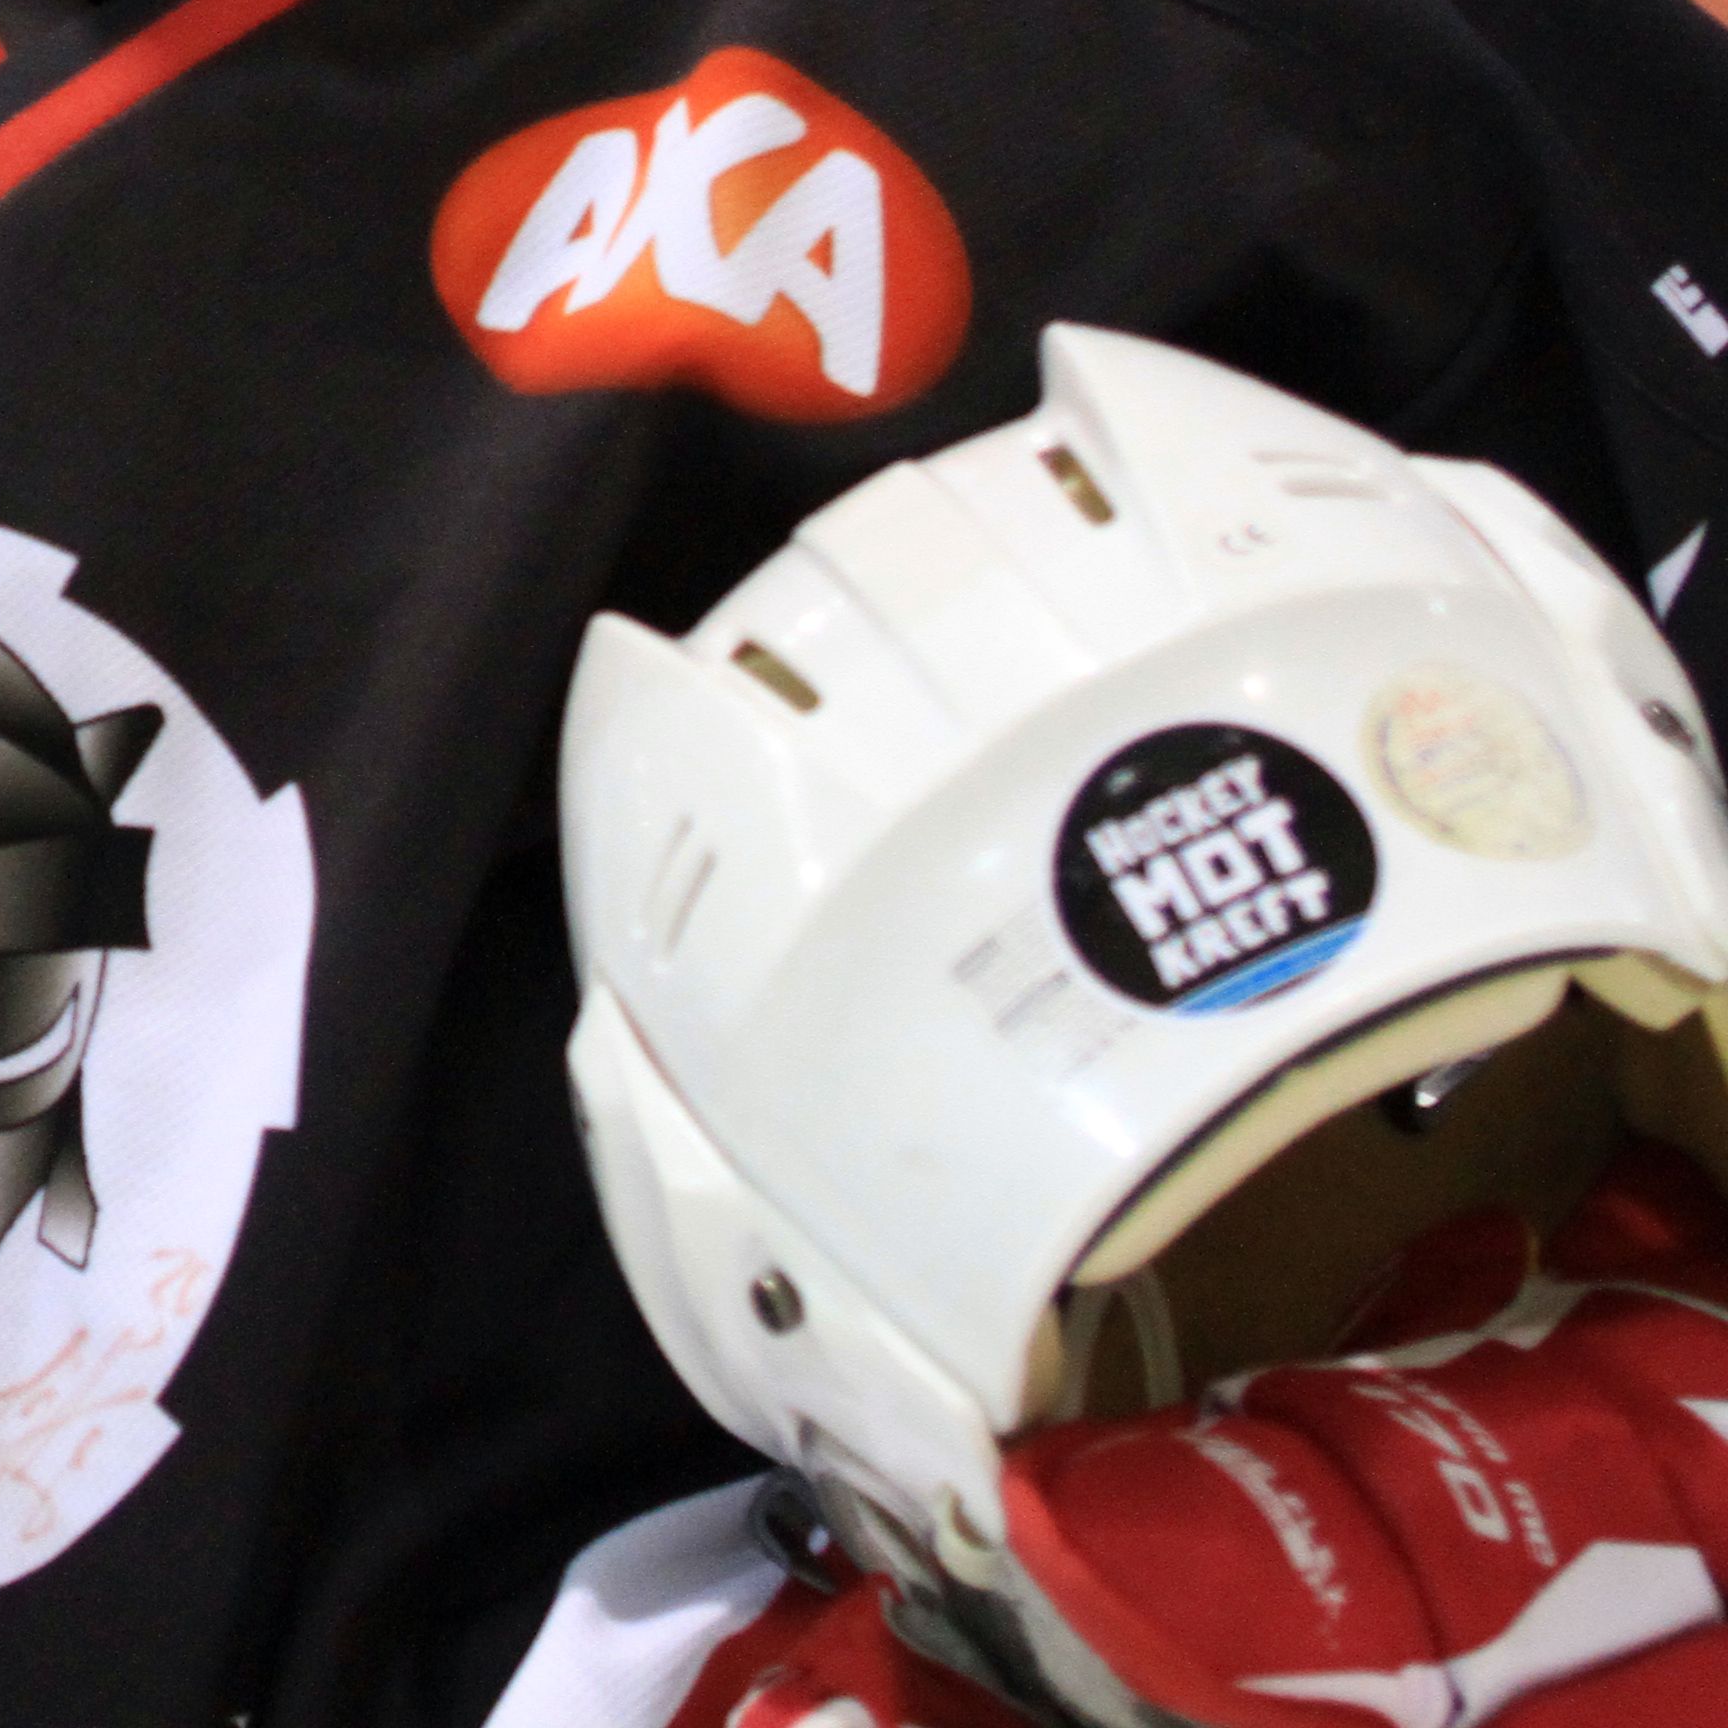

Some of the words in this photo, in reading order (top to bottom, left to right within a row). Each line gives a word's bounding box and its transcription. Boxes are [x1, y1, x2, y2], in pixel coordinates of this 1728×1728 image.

[475, 92, 884, 397] AXA
[1108, 794, 1307, 943] MOT
[1148, 866, 1332, 991] KREFT
